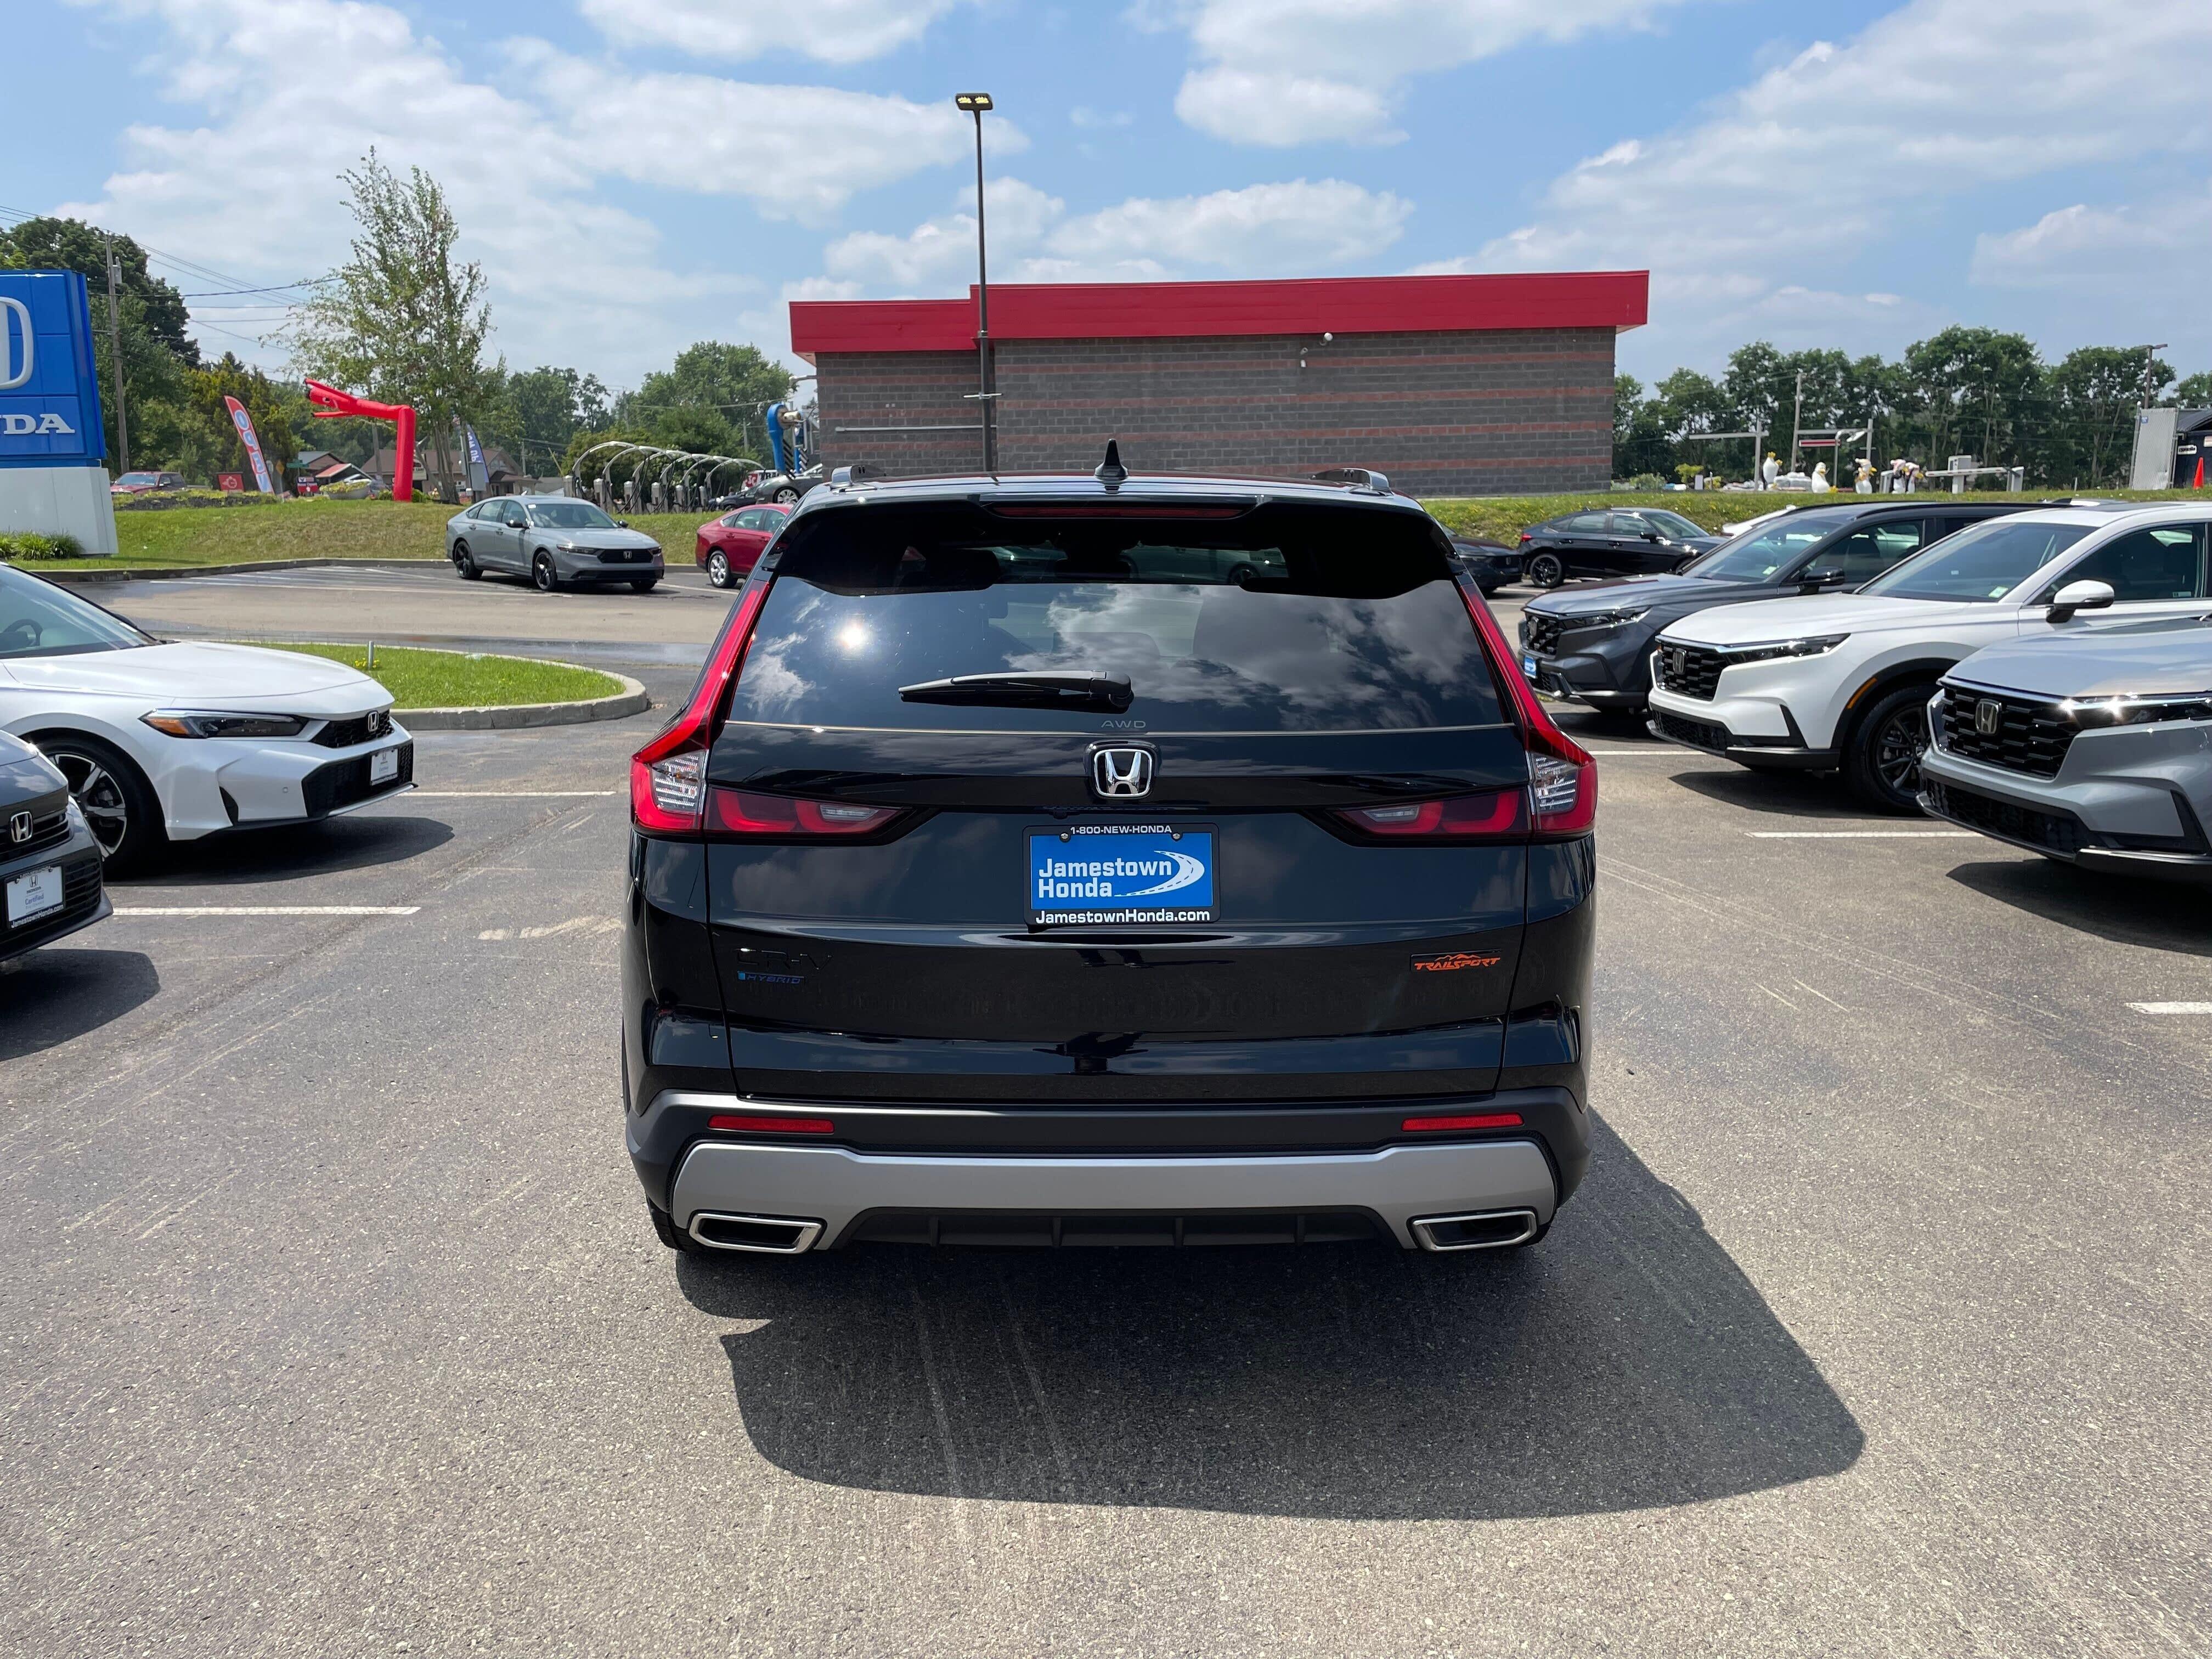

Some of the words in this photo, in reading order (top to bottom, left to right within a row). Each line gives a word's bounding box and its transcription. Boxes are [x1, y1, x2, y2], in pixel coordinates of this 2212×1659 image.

[0, 414, 75, 435] DA
[1101, 720, 1147, 729] AWD
[1070, 825, 1172, 835] 1-800-NEW-HONDA
[1039, 857, 1172, 878] Jamestown
[1039, 877, 1113, 899] Honda
[1035, 908, 1211, 924] JamestownHonda.com
[1414, 957, 1501, 972] TRAILSPORT
[746, 974, 801, 984] HYBRID
